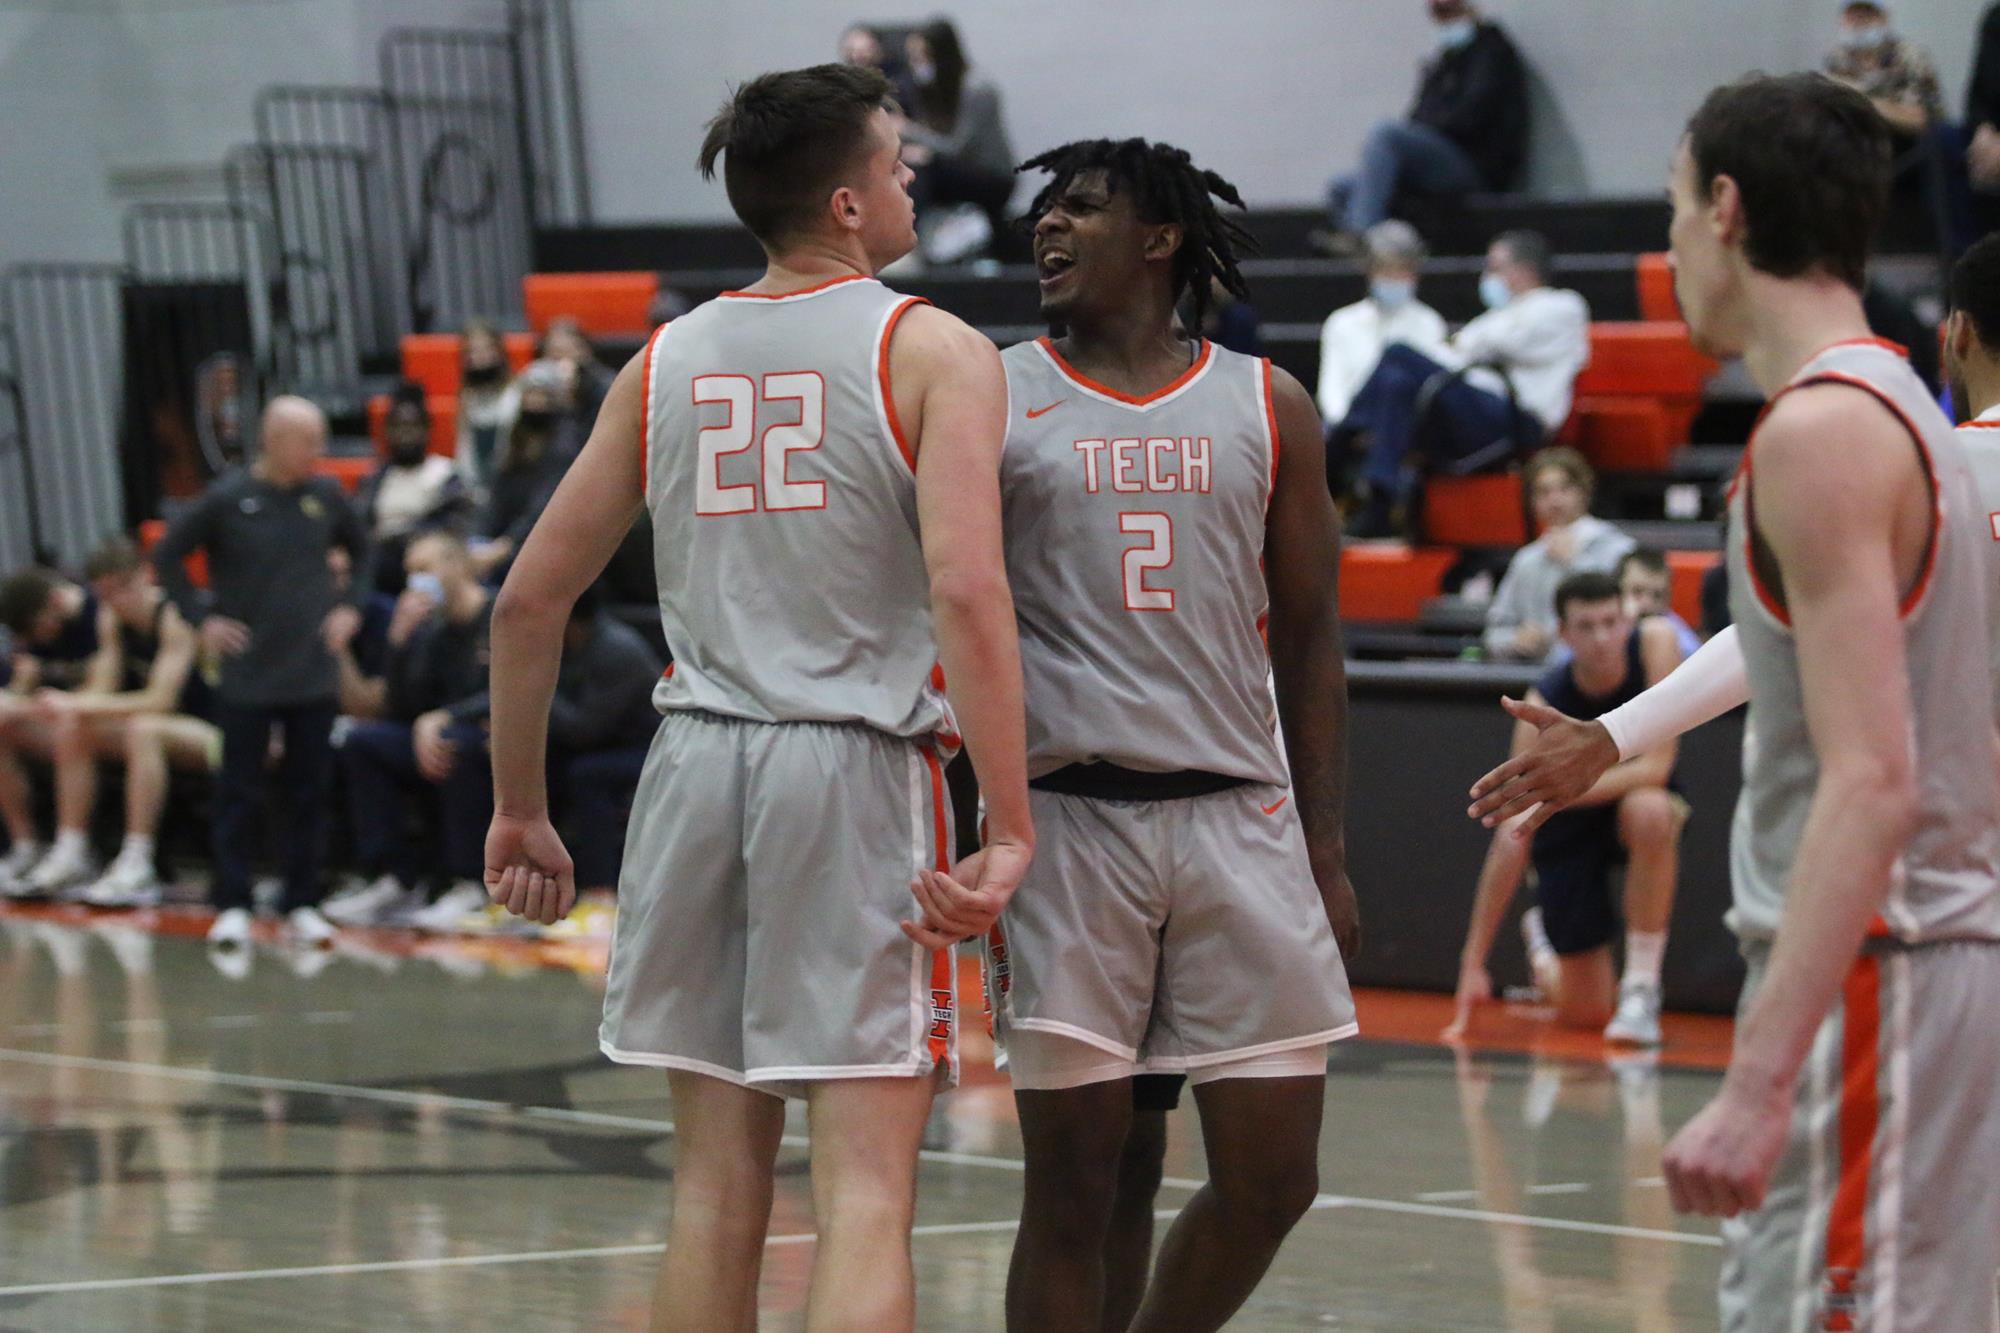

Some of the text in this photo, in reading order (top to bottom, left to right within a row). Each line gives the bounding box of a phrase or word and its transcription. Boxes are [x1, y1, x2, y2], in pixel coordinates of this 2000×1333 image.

[692, 369, 827, 516] 22
[1073, 437, 1212, 494] TECH
[1118, 511, 1176, 612] 2
